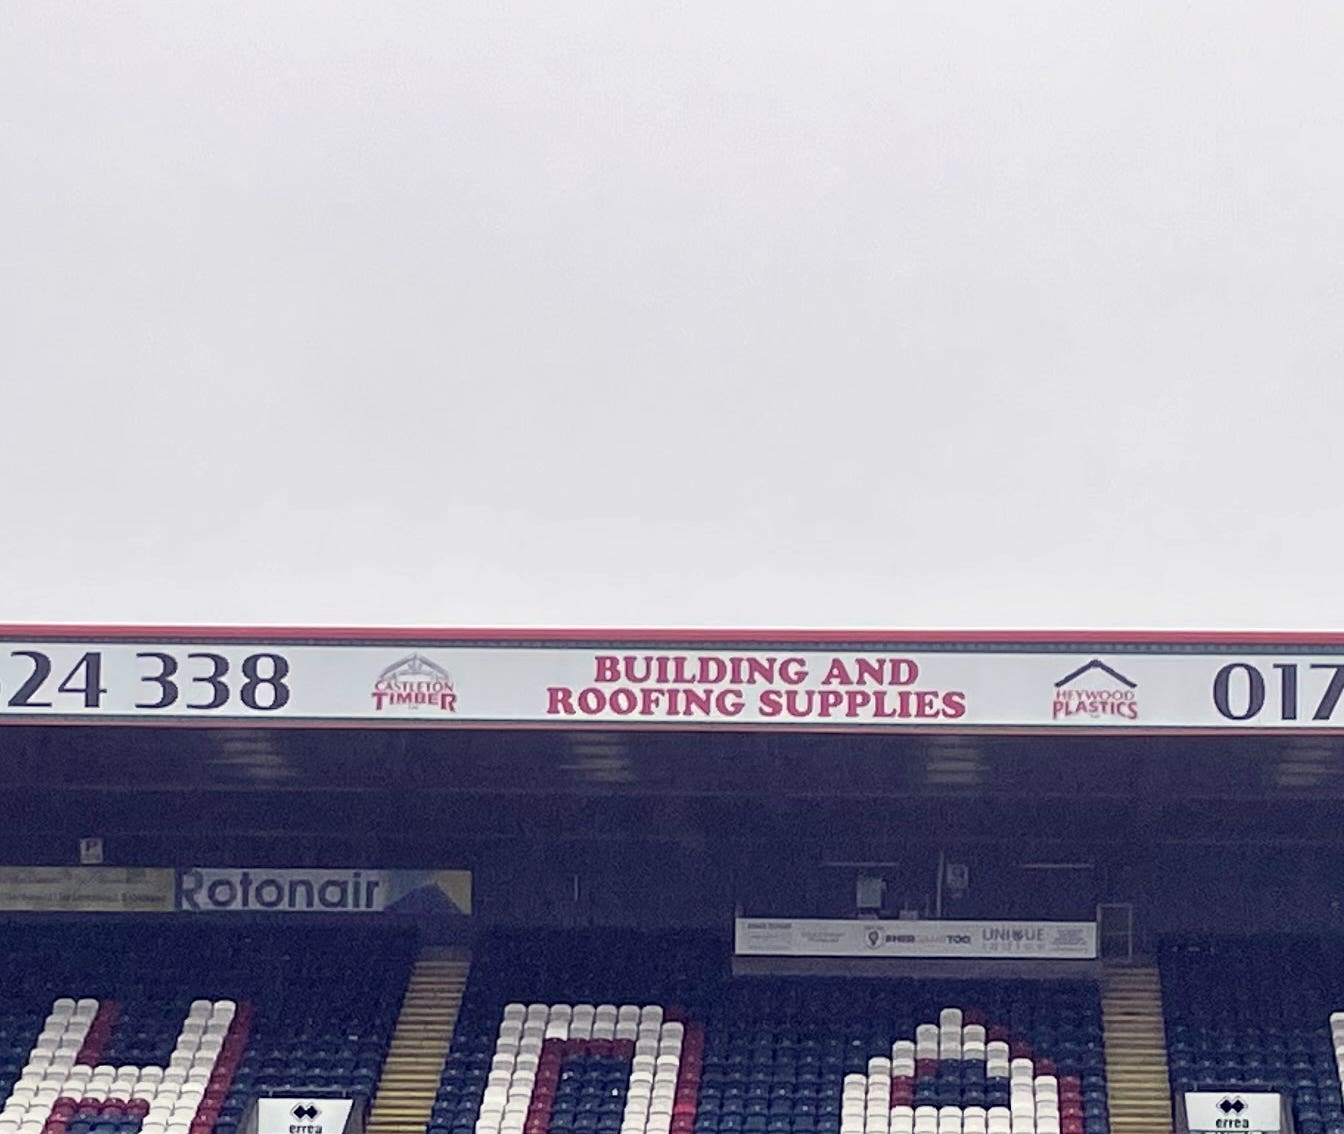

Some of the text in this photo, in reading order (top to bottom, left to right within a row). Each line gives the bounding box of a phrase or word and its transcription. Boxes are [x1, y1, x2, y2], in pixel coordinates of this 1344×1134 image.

[134, 652, 291, 712] 338
[594, 655, 920, 686] BUILDING AND
[374, 679, 454, 693] CASTLETON
[1056, 689, 1135, 701] HEYWOOD
[371, 691, 457, 712] TIMBER
[546, 688, 967, 719] ROOFING SUPPLIES
[1053, 700, 1138, 720] PLASTICS
[173, 870, 379, 911] Rotonair
